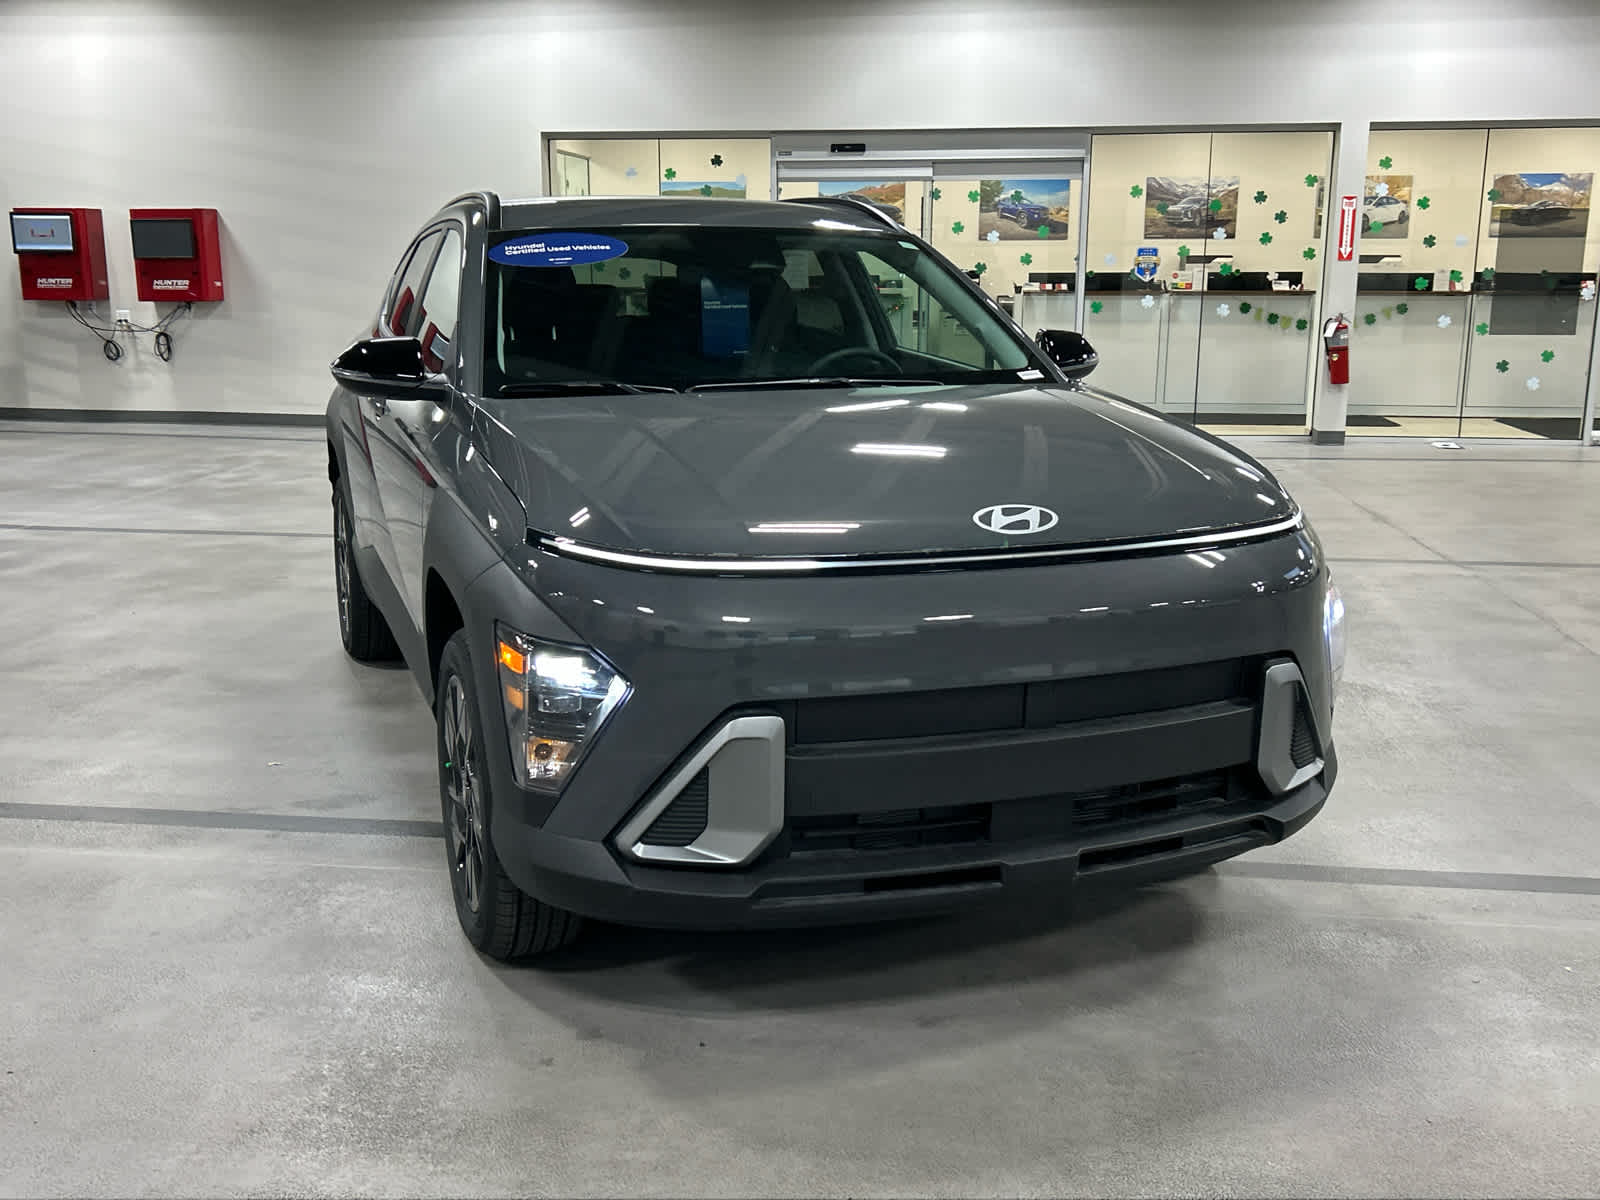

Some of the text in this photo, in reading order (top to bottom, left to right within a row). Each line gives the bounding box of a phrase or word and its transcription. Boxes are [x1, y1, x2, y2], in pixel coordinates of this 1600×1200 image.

[504, 242, 545, 251] Hyundai
[504, 243, 611, 256] Certified Used Vehicles
[153, 279, 190, 287] HUNTER
